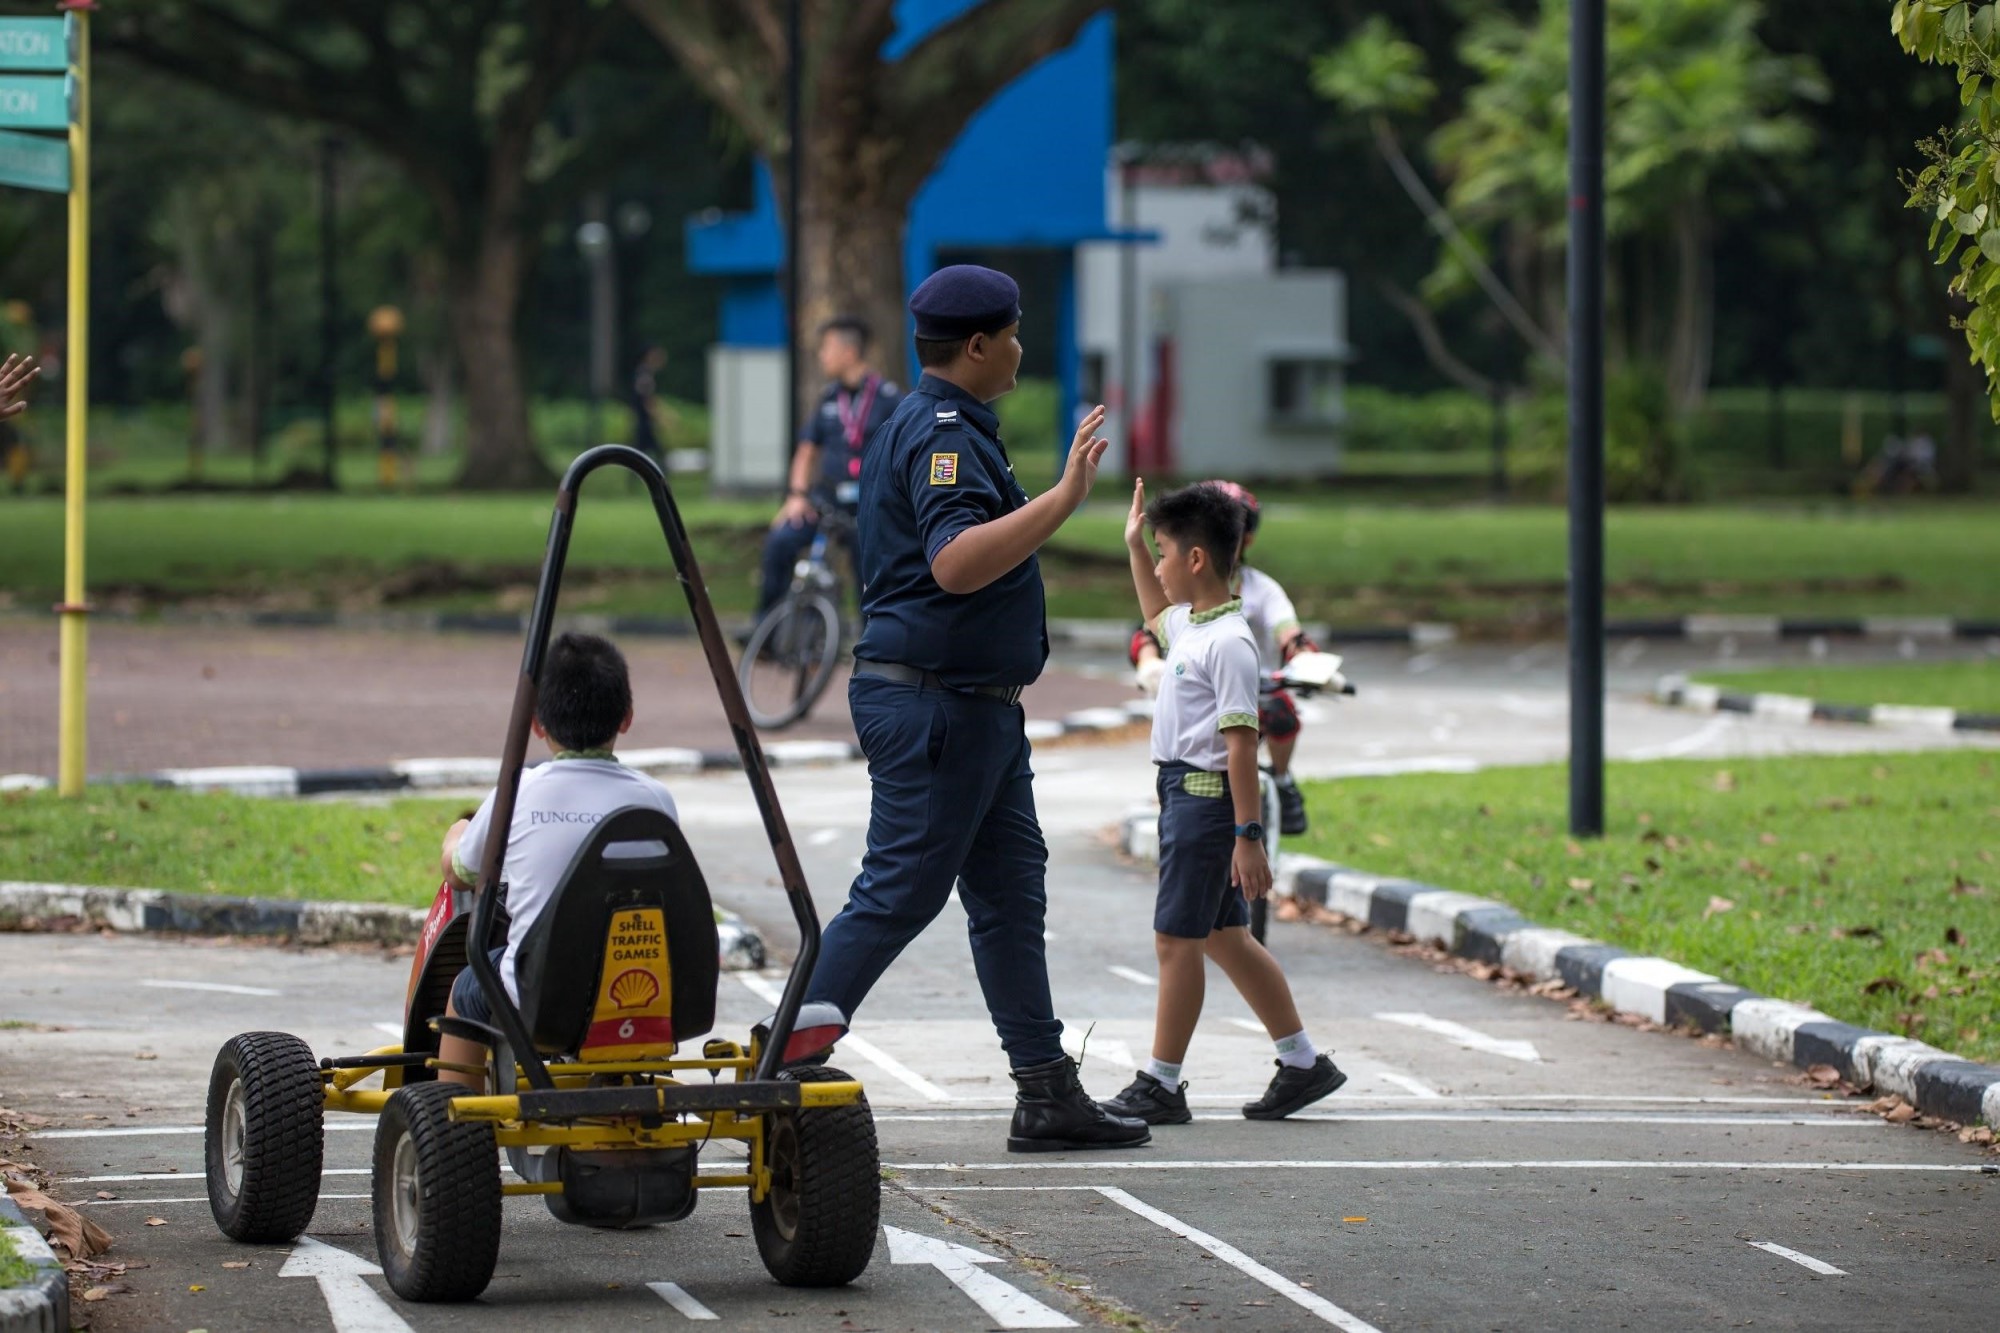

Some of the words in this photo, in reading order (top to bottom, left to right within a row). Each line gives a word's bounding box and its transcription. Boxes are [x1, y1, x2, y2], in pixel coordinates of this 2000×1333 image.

[531, 811, 607, 824] PUNGGO
[619, 921, 656, 932] SHELL
[611, 934, 661, 946] TRAFFIC
[613, 948, 659, 961] GAMES
[618, 1019, 634, 1039] 6
